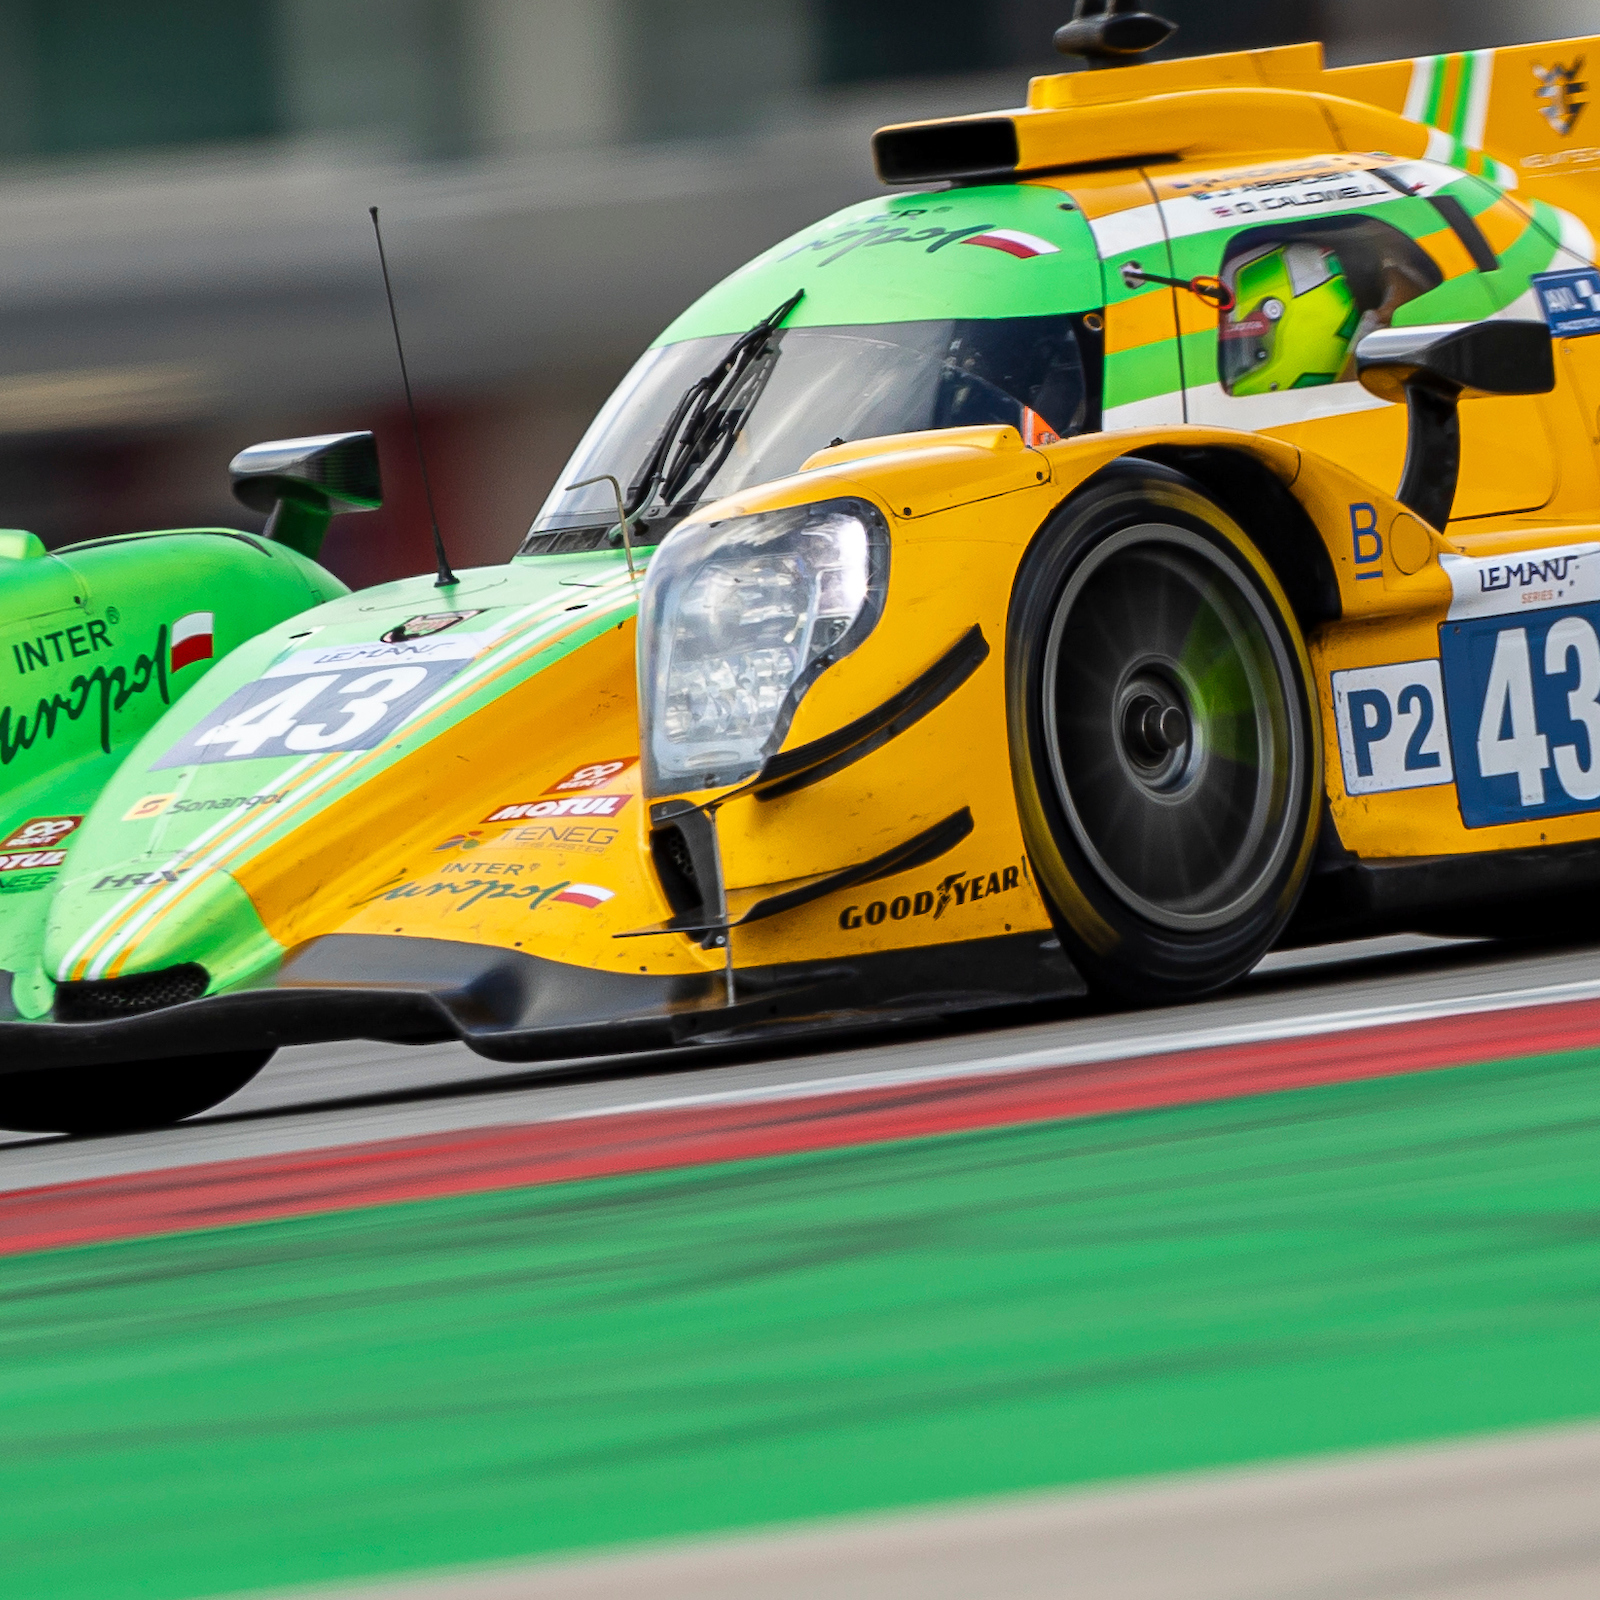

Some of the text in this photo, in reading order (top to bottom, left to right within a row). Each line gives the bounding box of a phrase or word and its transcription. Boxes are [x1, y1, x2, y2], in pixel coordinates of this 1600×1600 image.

[1350, 503, 1384, 566] B
[1521, 590, 1554, 604] SERIES
[12, 618, 114, 674] INTER
[194, 666, 428, 757] 43
[1347, 675, 1442, 777] P2
[165, 790, 290, 816] Sonangol
[487, 796, 622, 822] MOTUL
[500, 826, 619, 846] TENEG
[440, 862, 525, 876] INTER
[838, 865, 1020, 922] GOODYEAR
